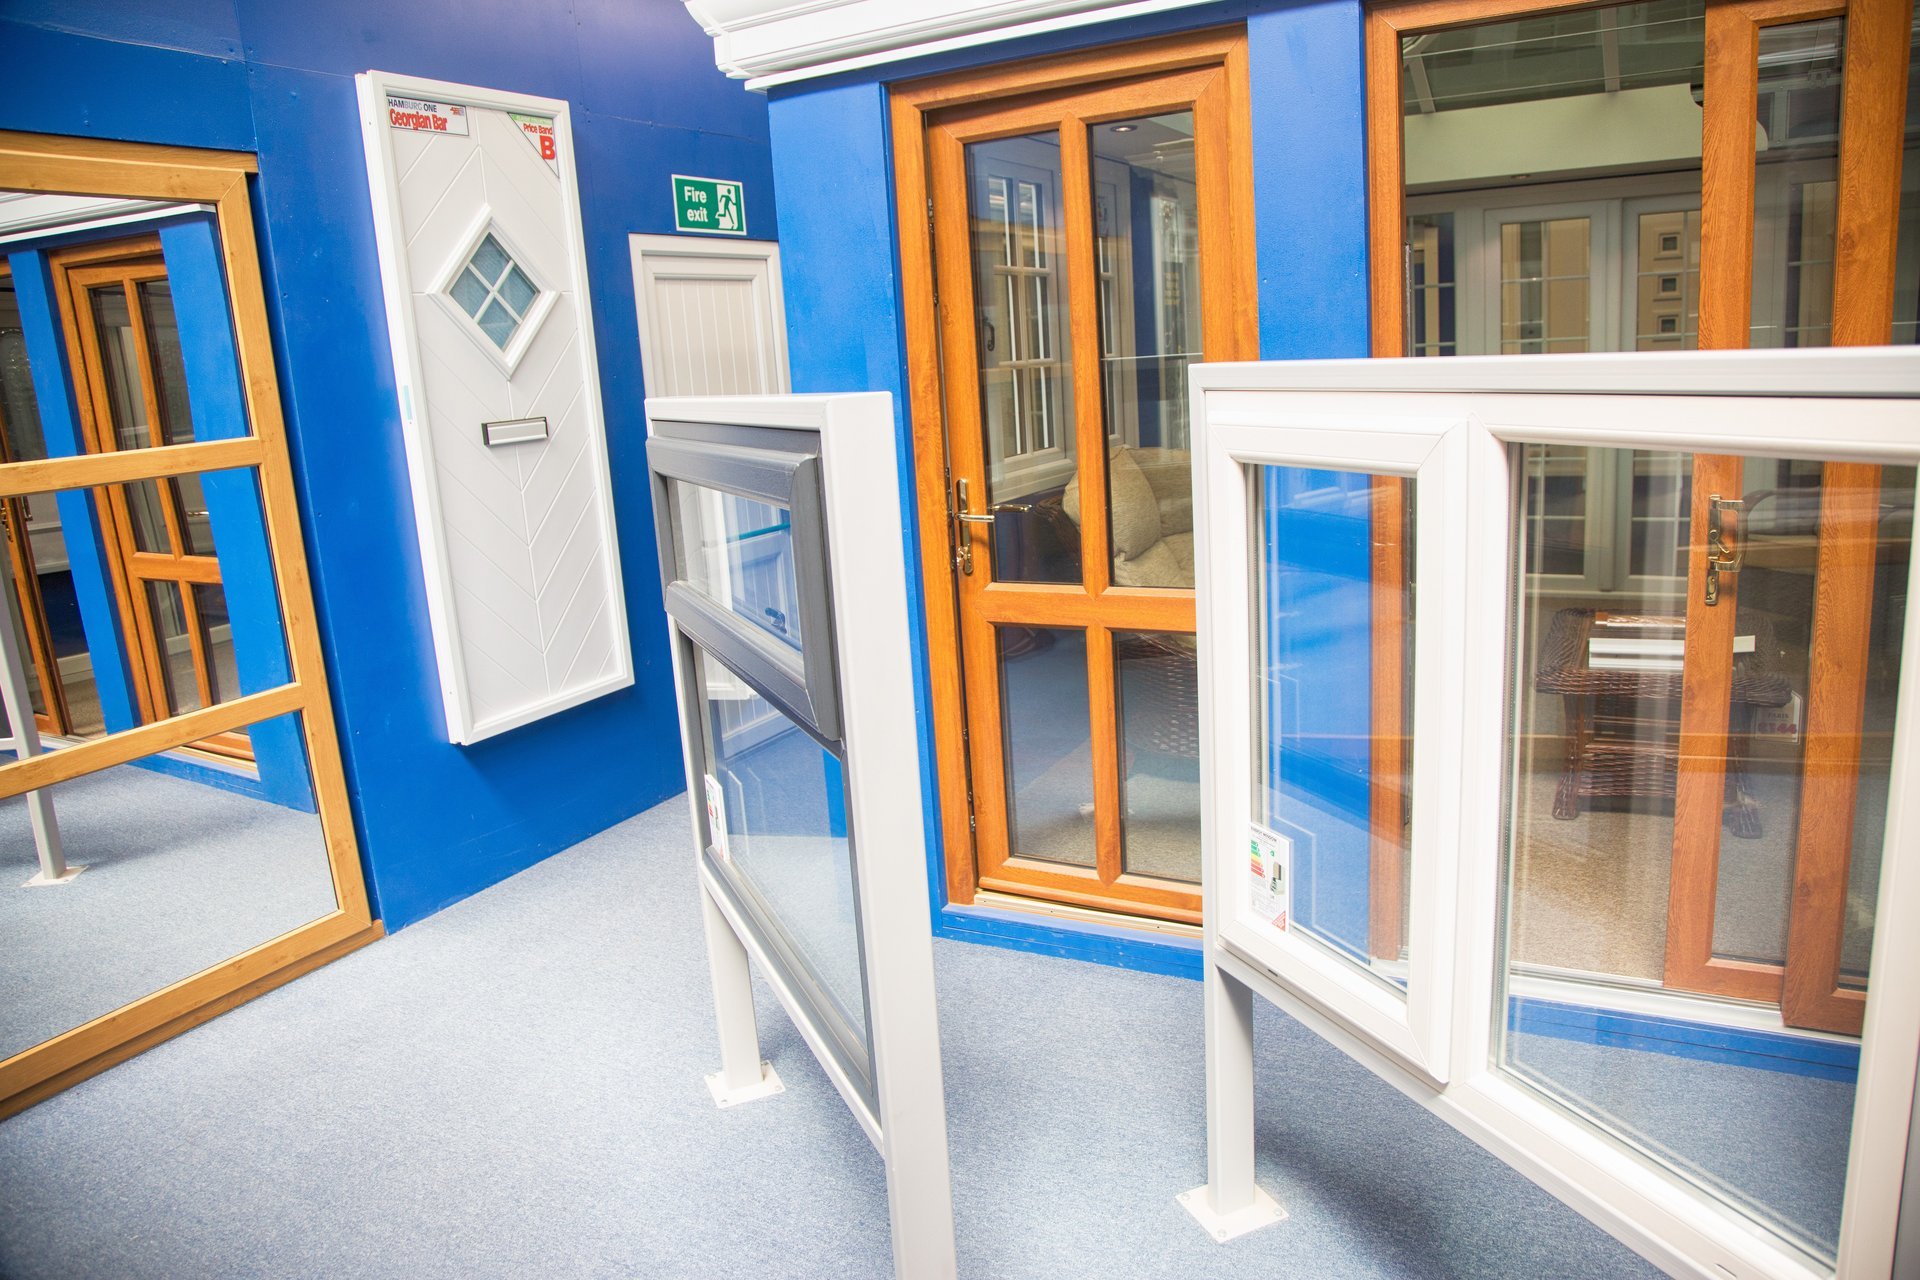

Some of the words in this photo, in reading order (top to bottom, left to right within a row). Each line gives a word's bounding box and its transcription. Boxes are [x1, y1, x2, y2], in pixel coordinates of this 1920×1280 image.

[388, 99, 422, 111] HAMBURG
[423, 103, 437, 113] ONE
[389, 108, 432, 130] Georgian
[432, 113, 448, 131] Bar
[523, 122, 538, 134] Price
[538, 124, 553, 135] Band
[540, 135, 556, 160] B
[684, 185, 707, 203] Fire
[687, 206, 708, 222] exit
